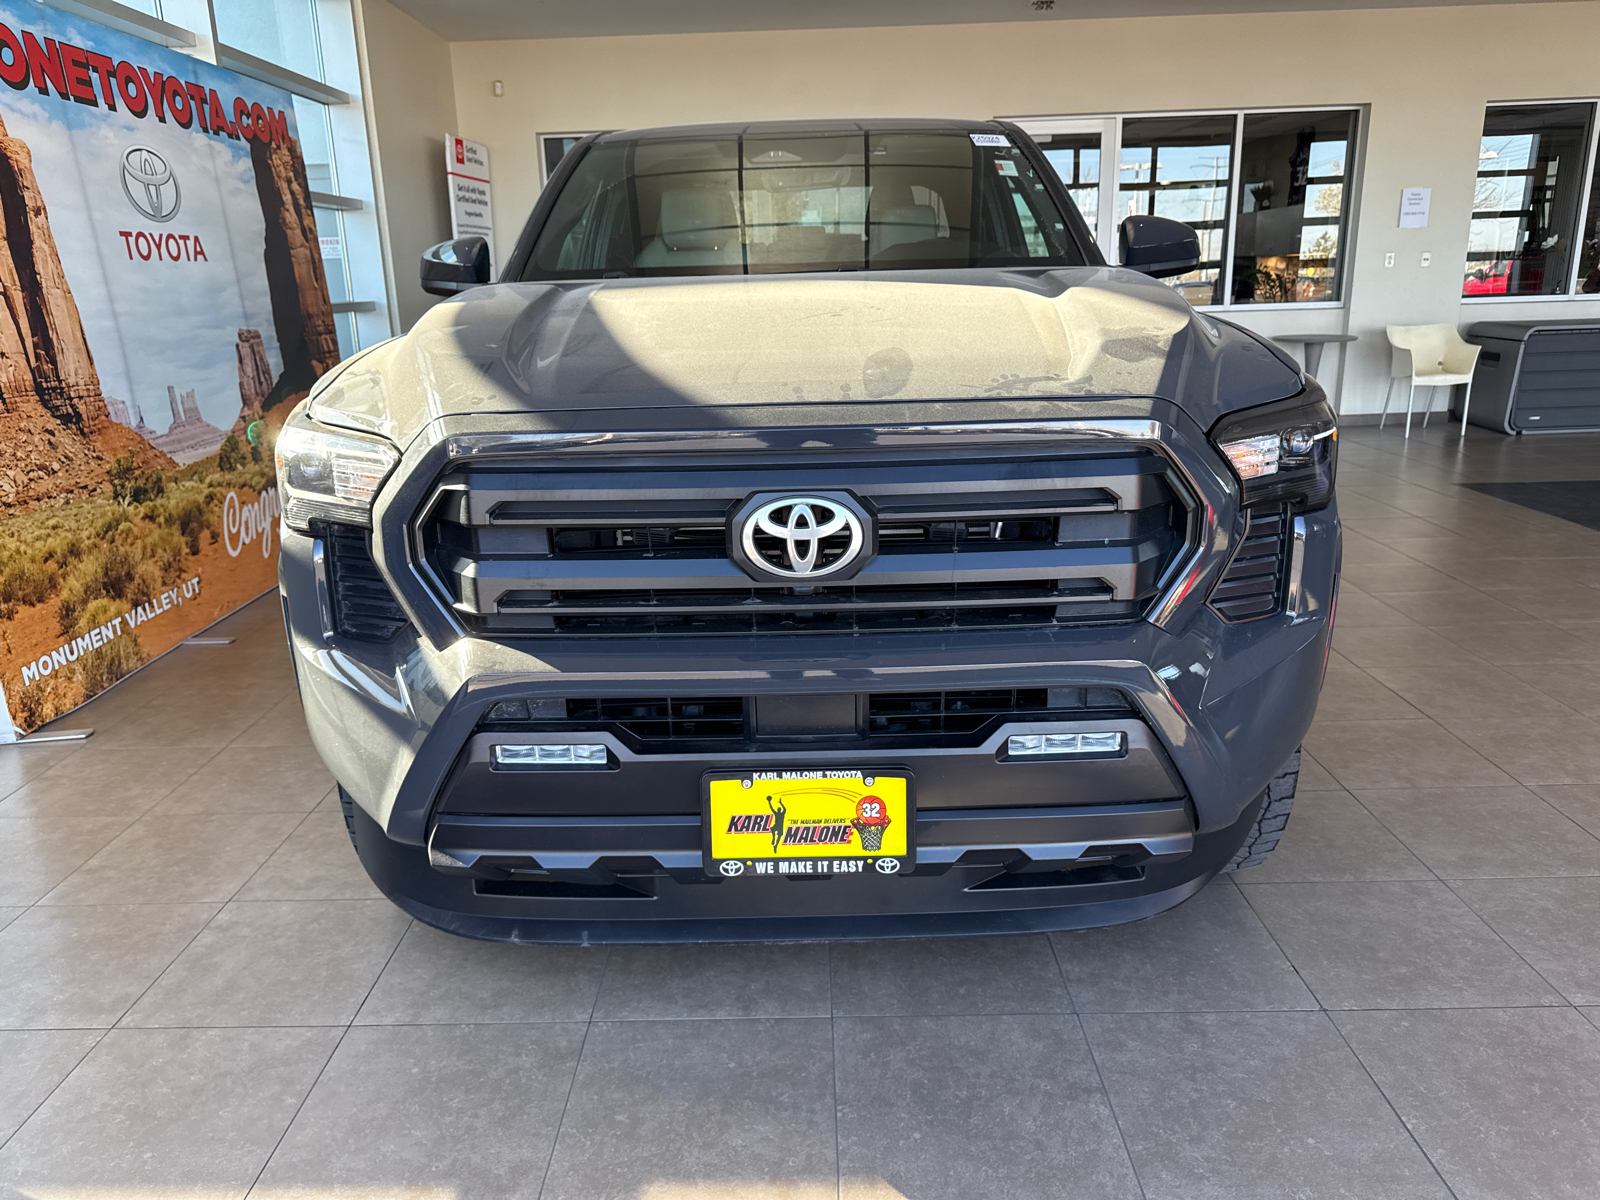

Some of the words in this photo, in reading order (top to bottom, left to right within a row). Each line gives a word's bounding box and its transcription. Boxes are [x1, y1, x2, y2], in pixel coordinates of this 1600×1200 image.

[119, 230, 209, 263] TOYOTA
[21, 617, 122, 687] MONUMENT
[124, 586, 183, 630] VALLEY,
[183, 576, 201, 601] UT
[752, 772, 779, 781] KARL
[782, 771, 823, 780] MALONE
[825, 770, 863, 779] TOYOTA
[862, 802, 881, 818] 32
[726, 814, 774, 834] KARL
[782, 825, 854, 845] MALONE
[755, 861, 775, 874] WE
[778, 860, 814, 874] MAKE
[817, 860, 829, 873] IT
[832, 860, 864, 873] EASY
